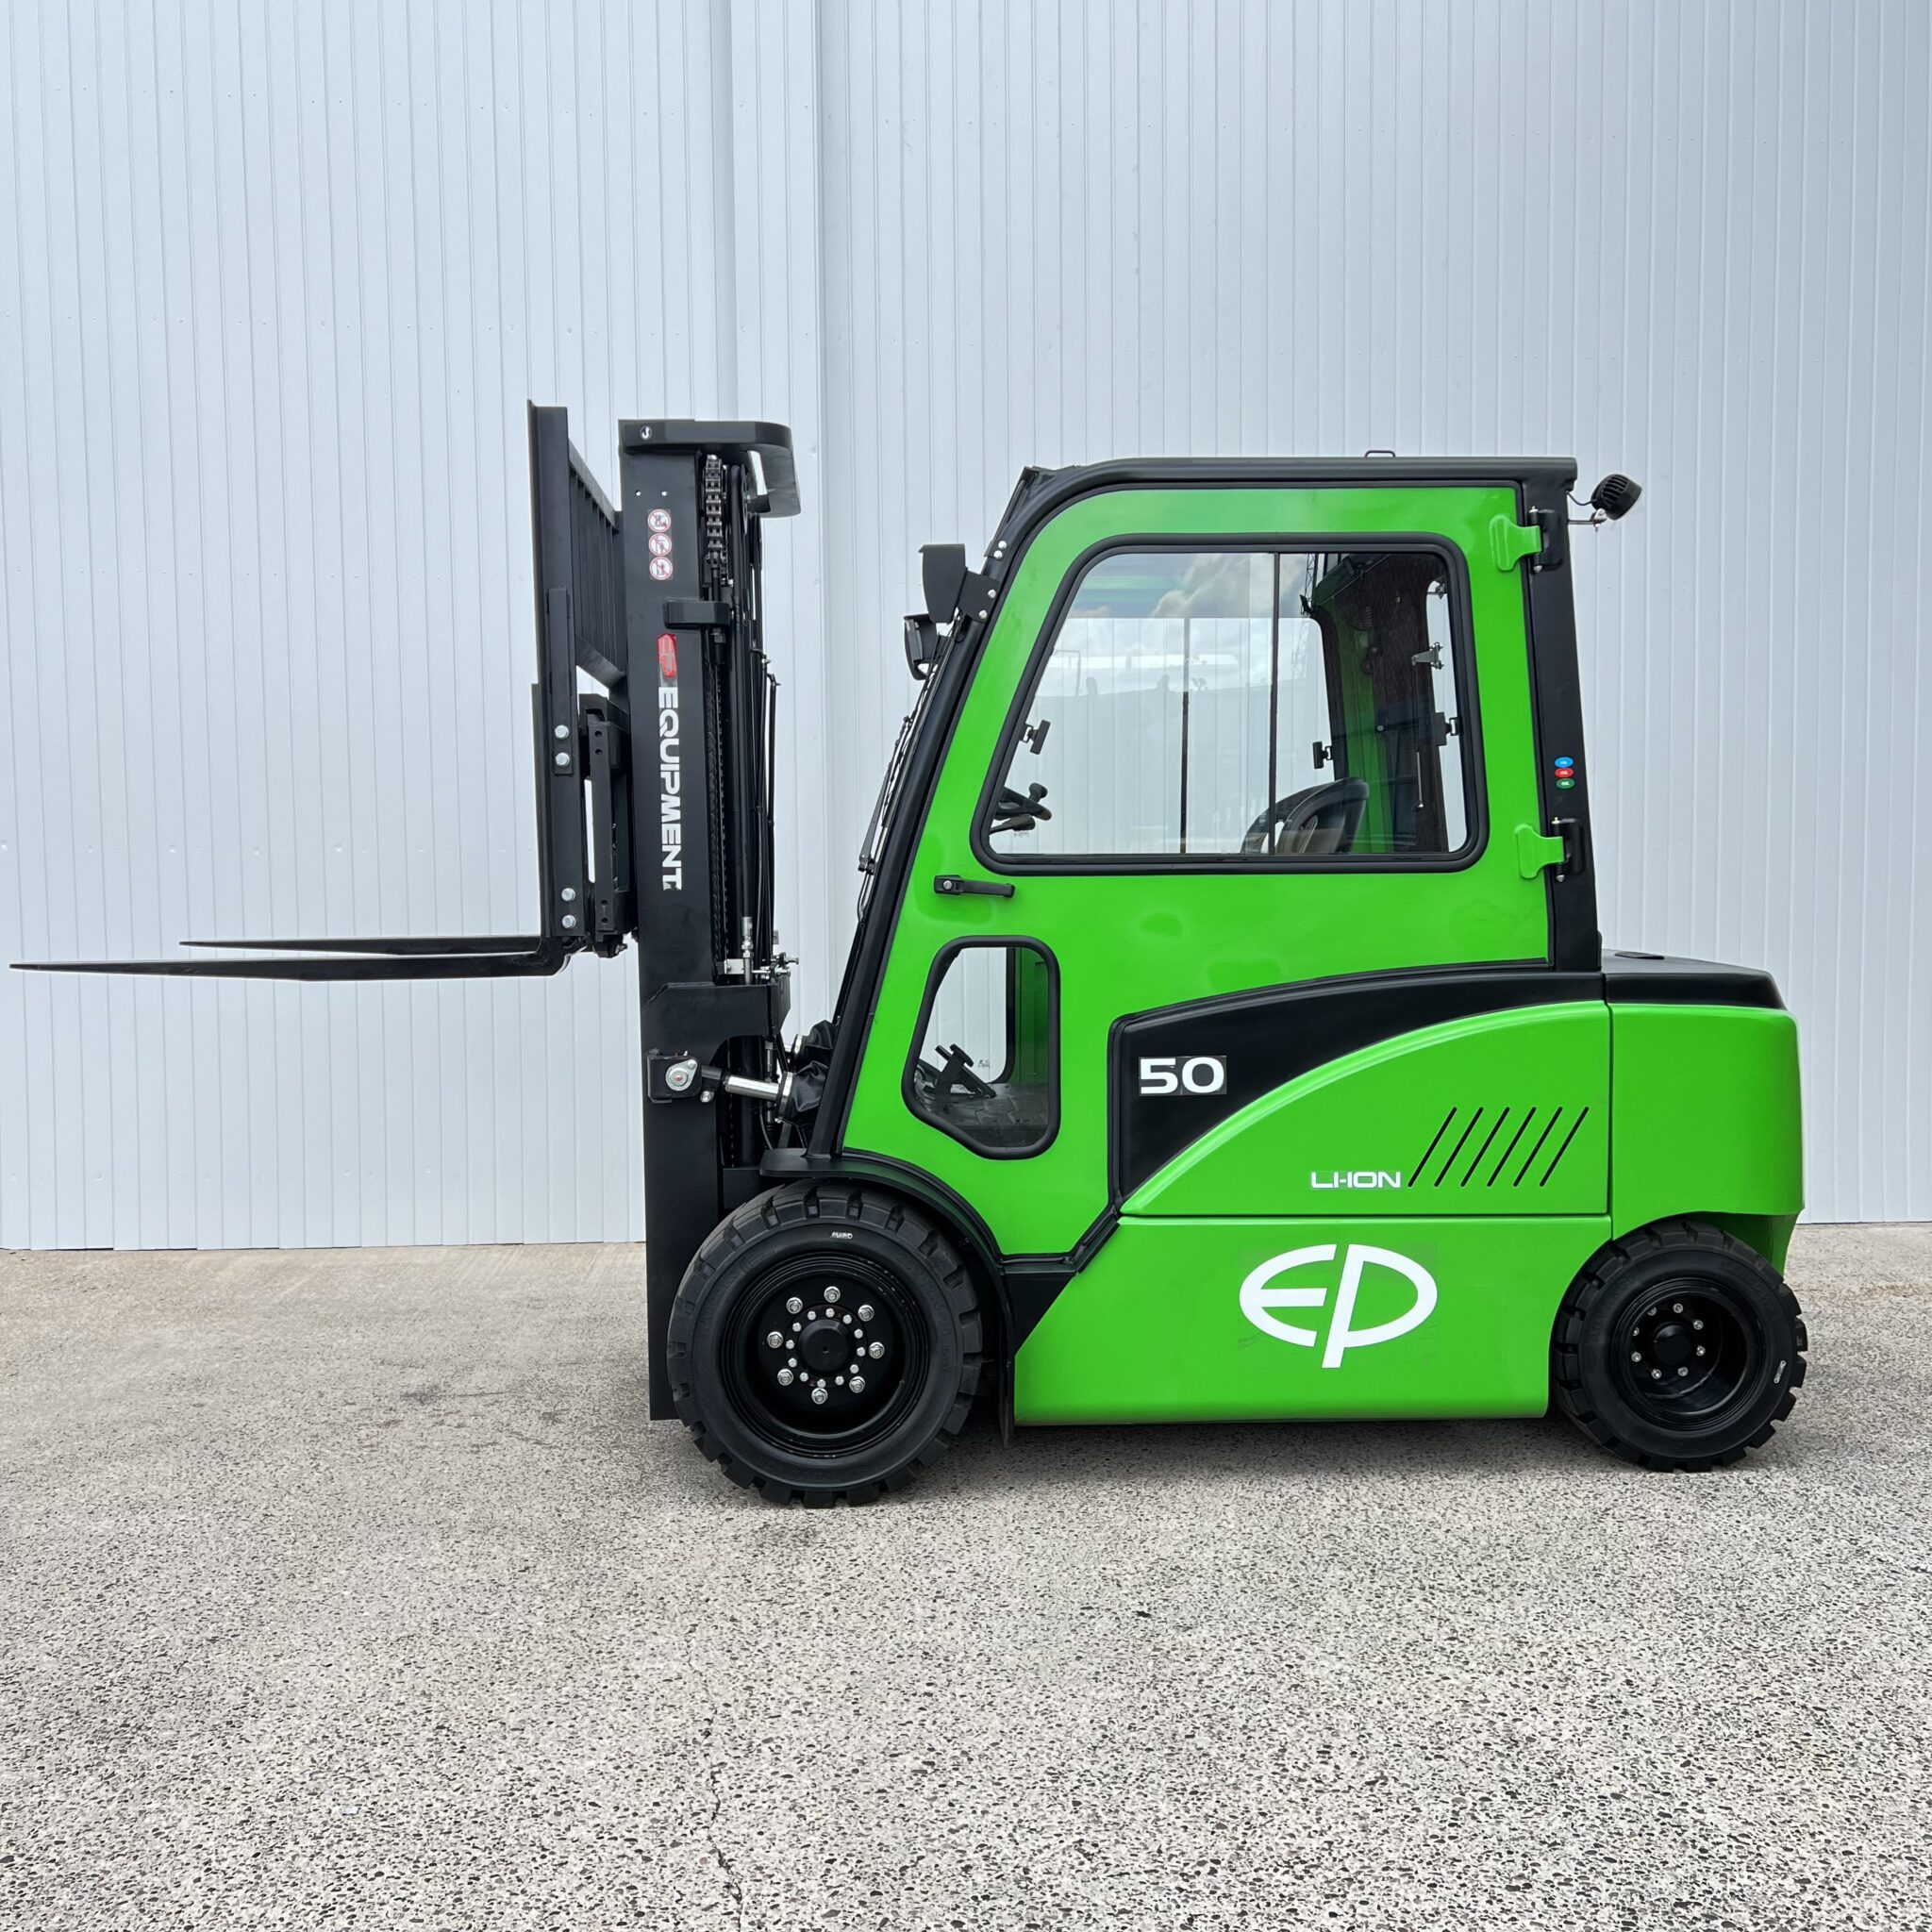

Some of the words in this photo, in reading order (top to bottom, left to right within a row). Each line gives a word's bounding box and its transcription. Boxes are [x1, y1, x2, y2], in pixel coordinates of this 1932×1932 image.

[658, 687, 682, 891] EQUIPMENT
[1141, 1057, 1224, 1094] 50
[1310, 1172, 1401, 1189] LI-ION
[1239, 1243, 1438, 1369] EP
